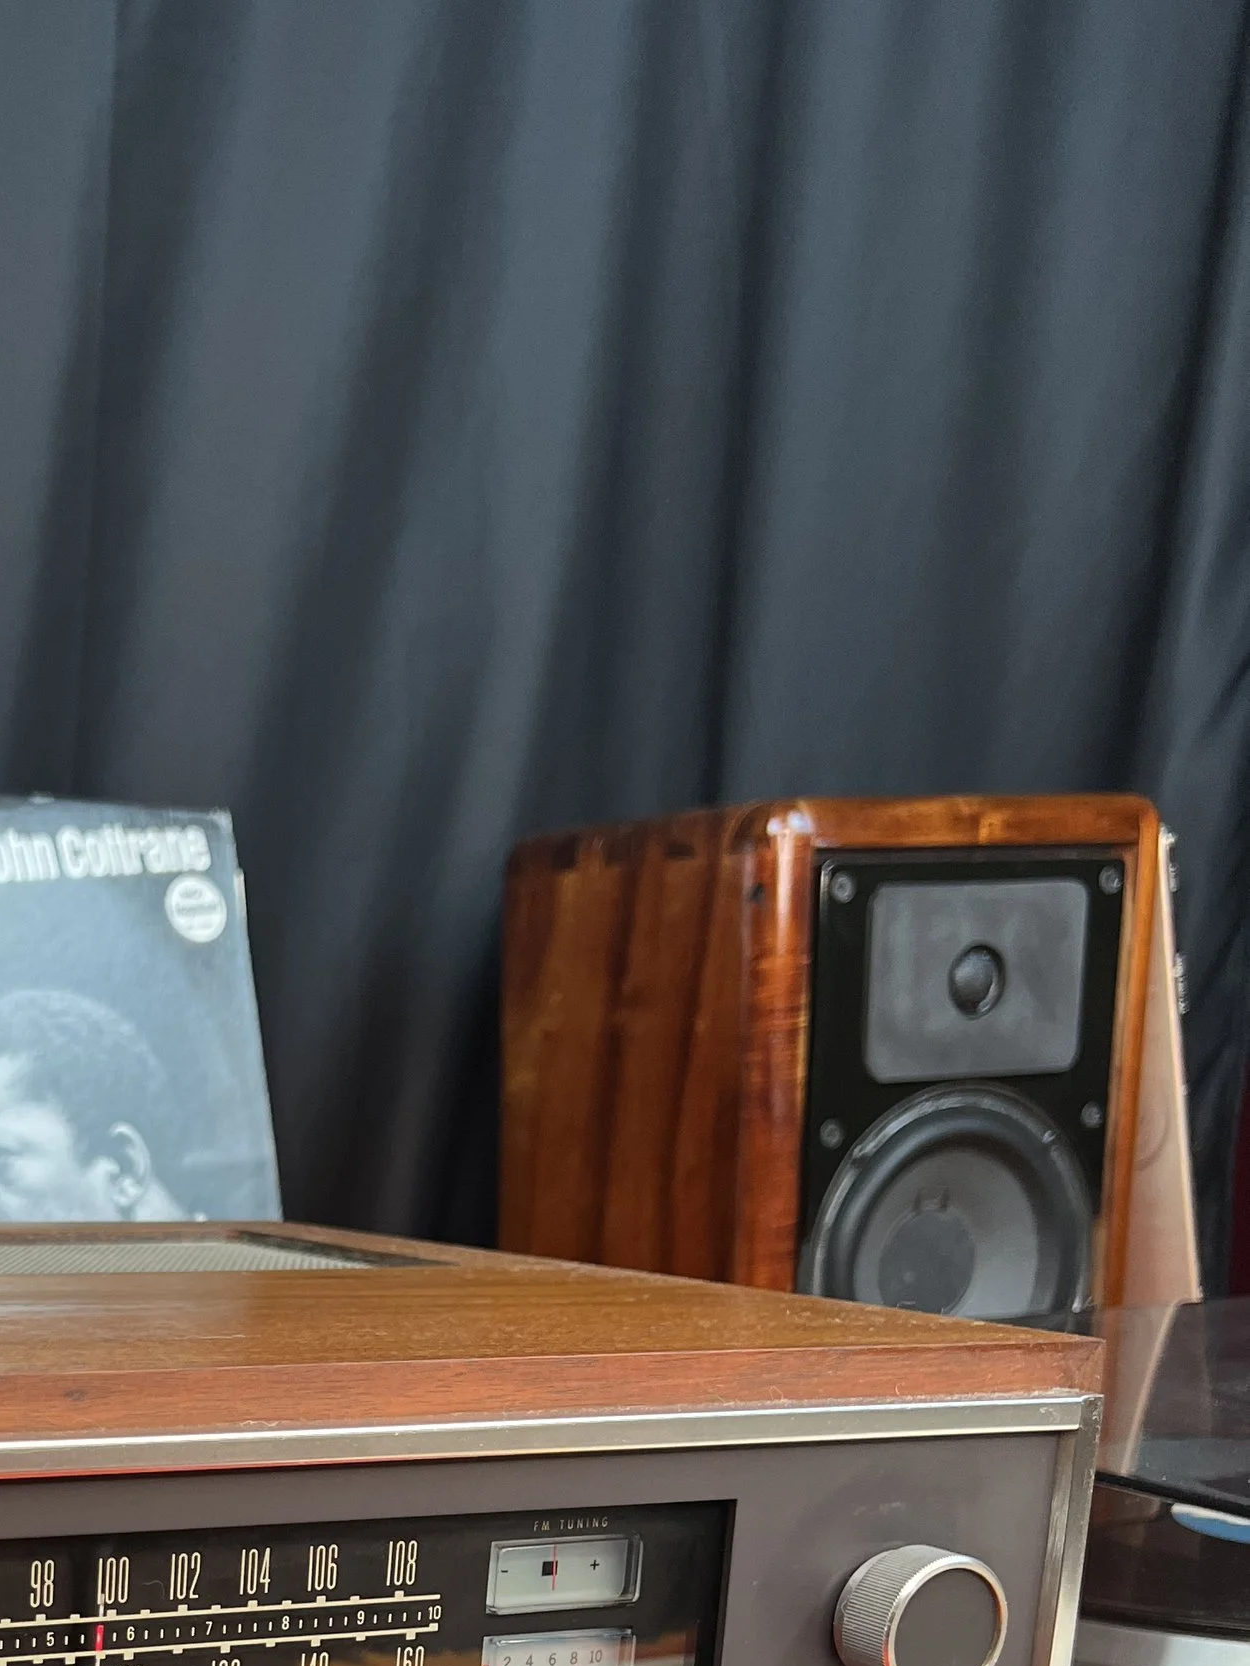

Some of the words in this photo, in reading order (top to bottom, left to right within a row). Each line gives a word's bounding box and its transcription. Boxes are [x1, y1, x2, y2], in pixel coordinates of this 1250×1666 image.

[55, 824, 211, 879] Coltrane
[534, 1520, 550, 1532] FM
[560, 1516, 609, 1530] TUNING
[30, 1560, 55, 1607] 98
[97, 1556, 130, 1605] 100
[170, 1552, 201, 1600] 102
[240, 1547, 272, 1595] 104
[307, 1544, 339, 1591] 106
[386, 1540, 418, 1587] 108
[46, 1632, 54, 1647] 5
[127, 1627, 135, 1642] 6
[205, 1621, 213, 1636] 7
[282, 1616, 290, 1631] 8
[357, 1611, 365, 1625] 9
[428, 1605, 441, 1620] 10
[526, 1655, 533, 1666] 4
[548, 1653, 557, 1666] 6
[570, 1652, 578, 1665] 8
[590, 1650, 602, 1664] 10
